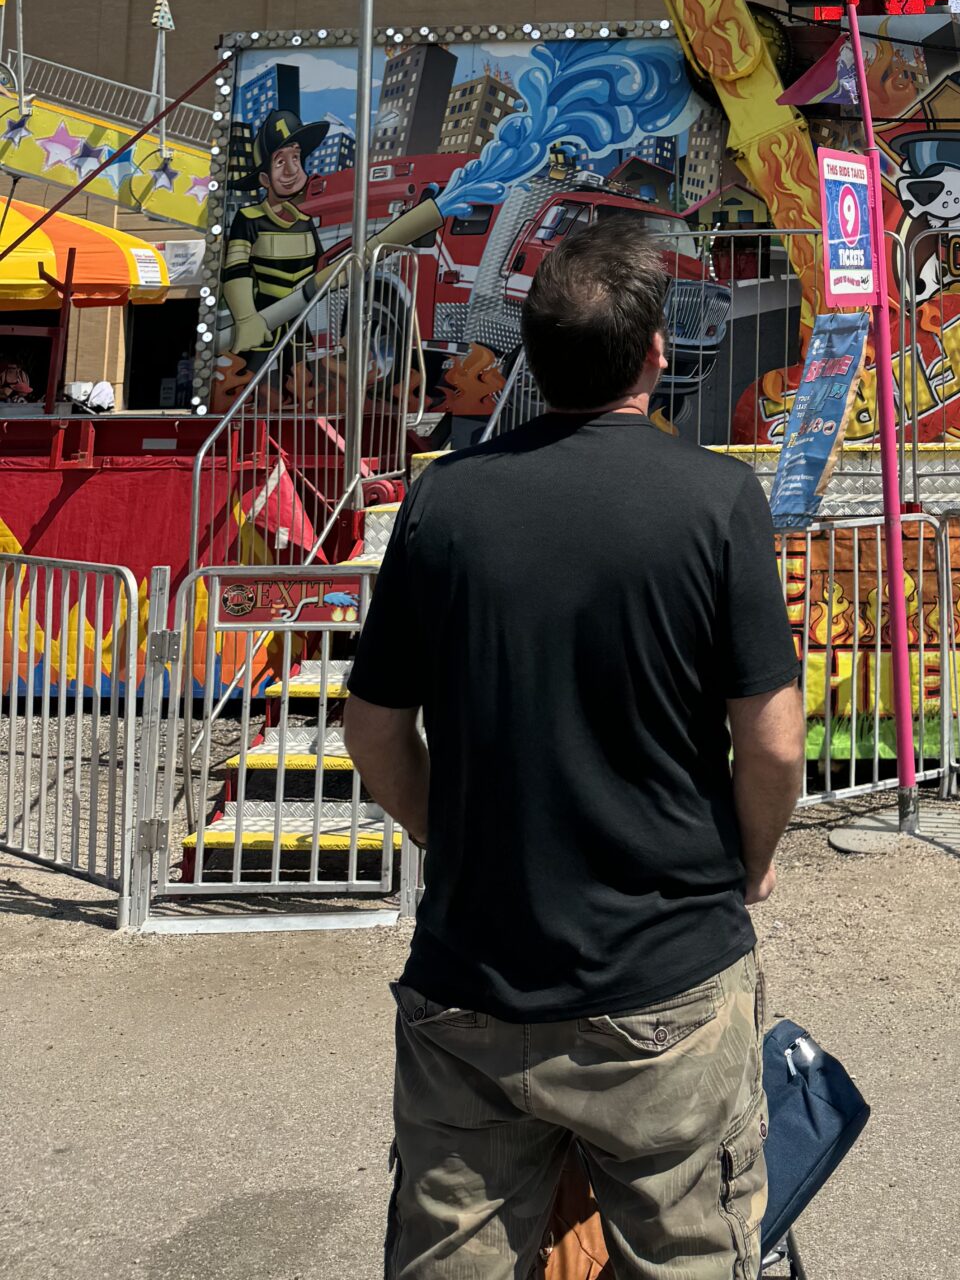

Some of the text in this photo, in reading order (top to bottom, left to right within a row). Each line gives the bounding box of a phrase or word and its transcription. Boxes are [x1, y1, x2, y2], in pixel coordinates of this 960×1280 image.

[275, 118, 291, 139] 1
[827, 164, 838, 175] THIS
[843, 194, 856, 235] 9
[838, 248, 865, 267] TICKETS
[255, 580, 333, 609] EXIT
